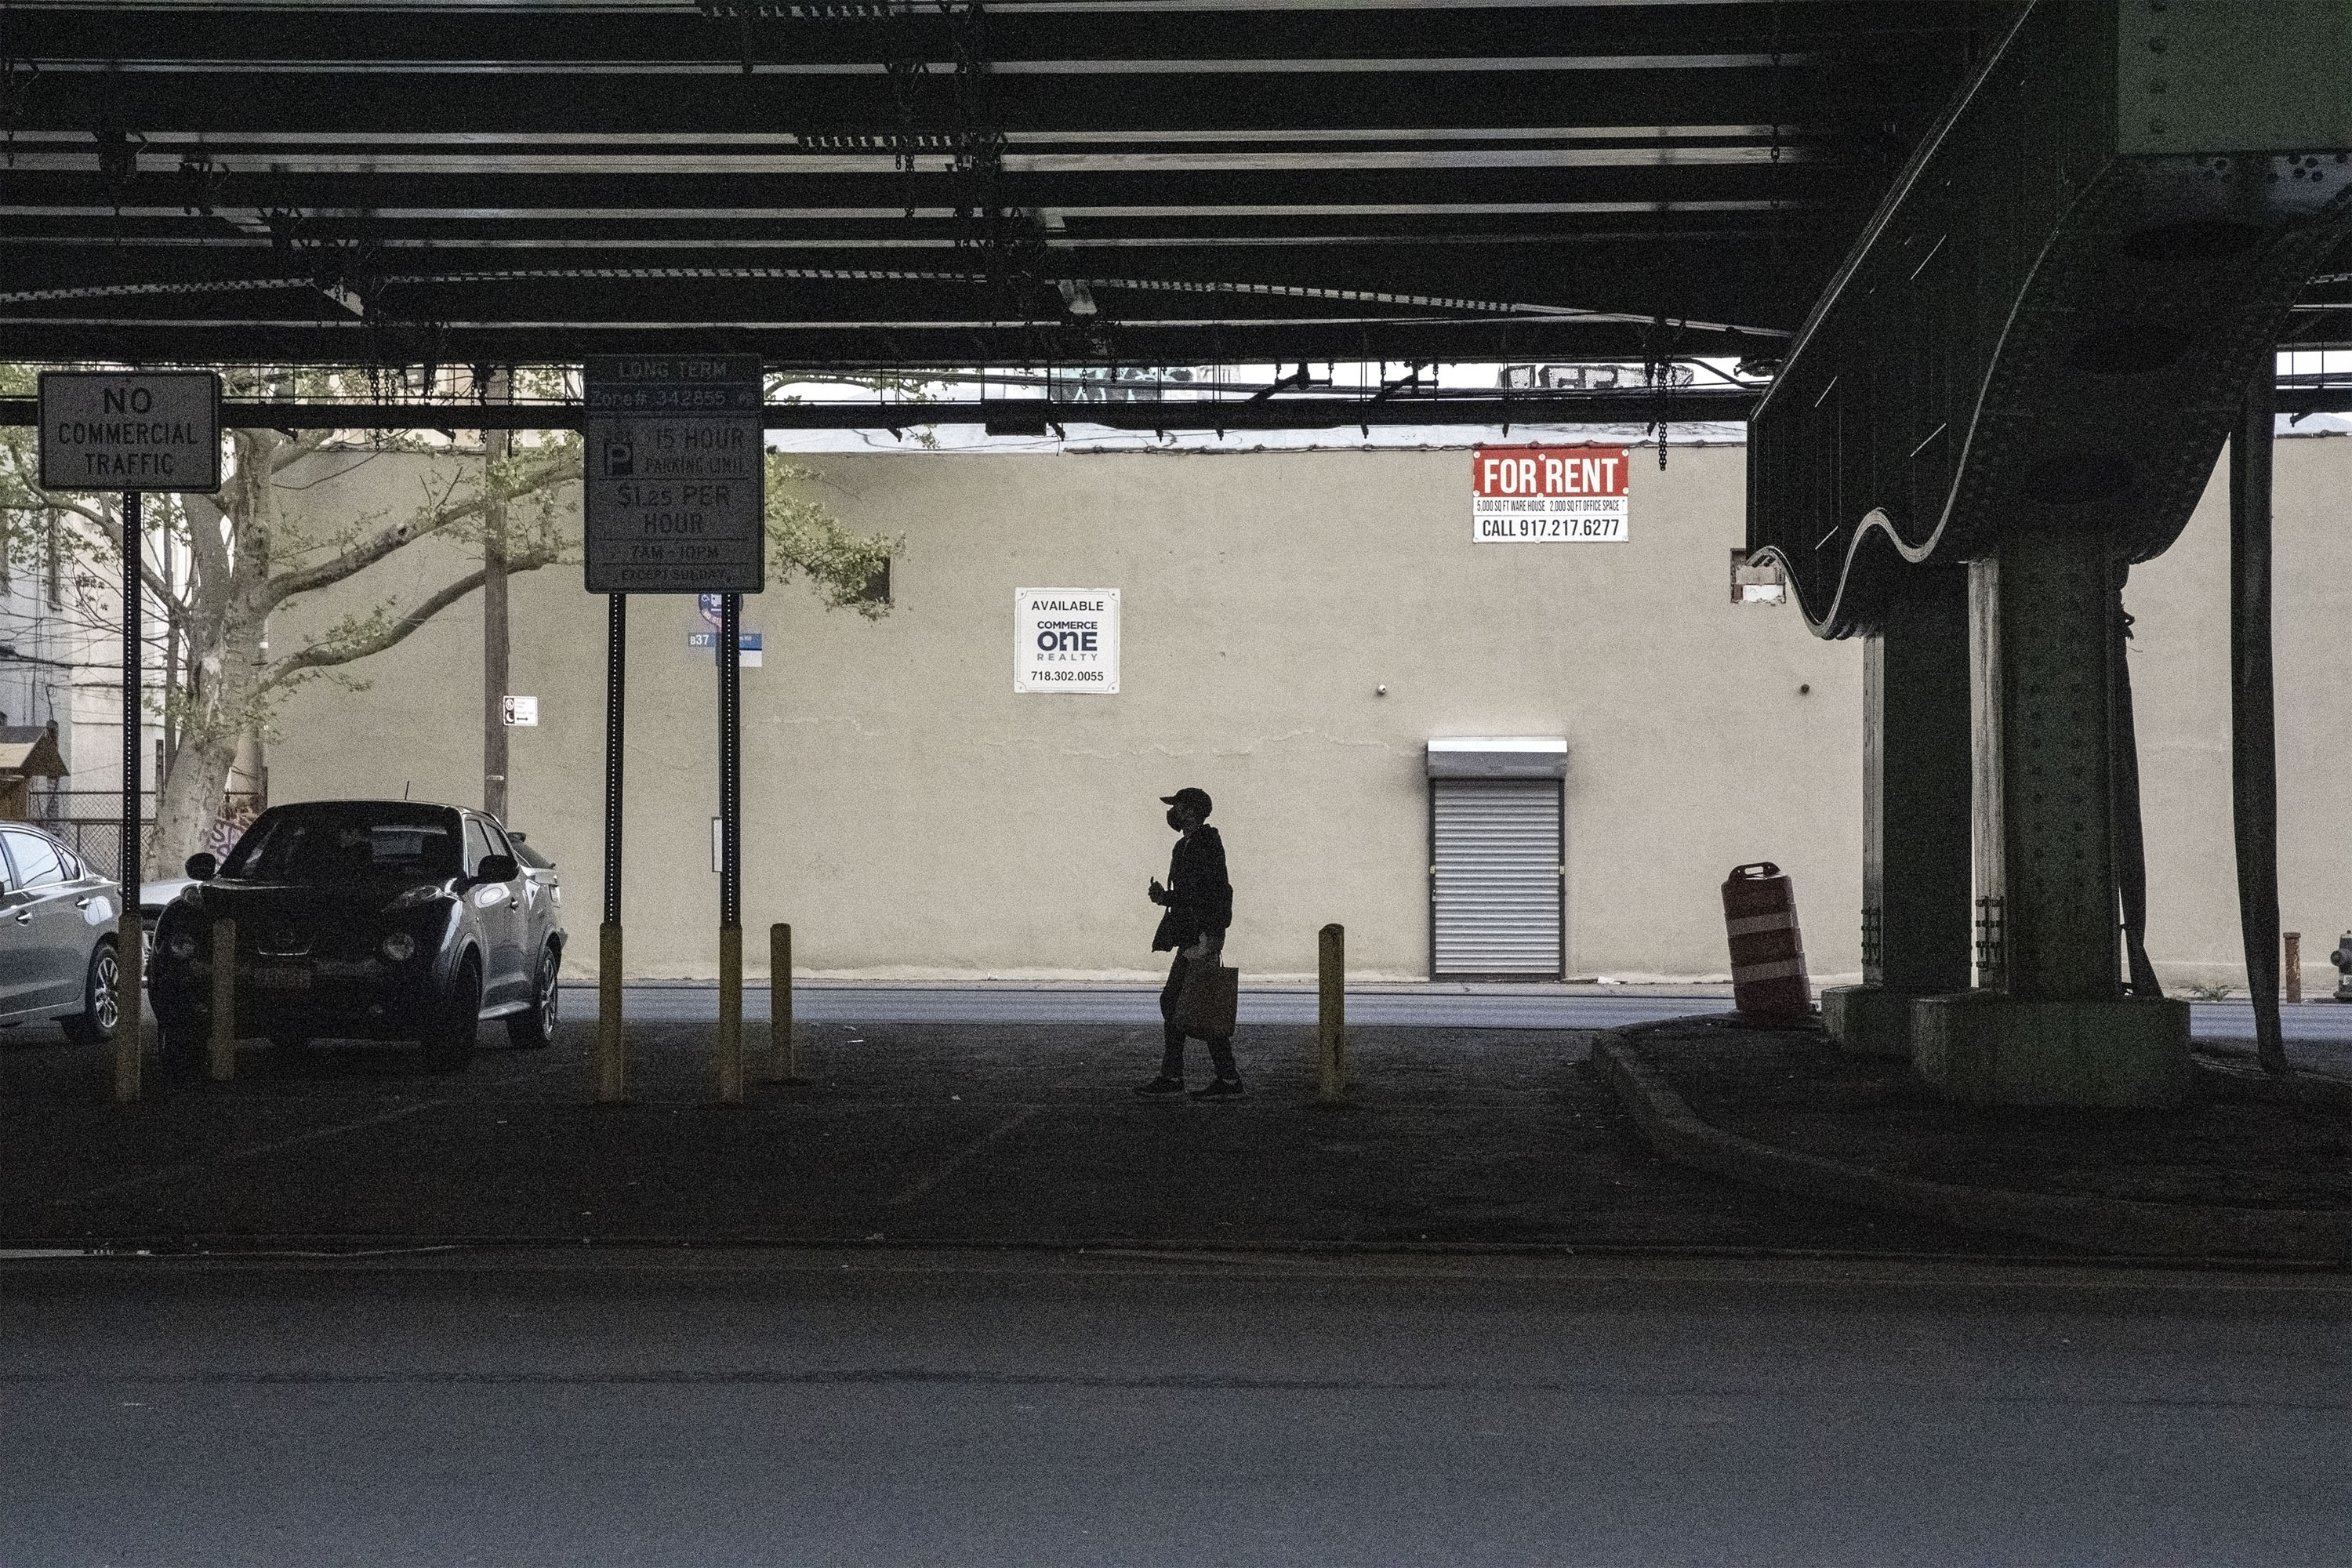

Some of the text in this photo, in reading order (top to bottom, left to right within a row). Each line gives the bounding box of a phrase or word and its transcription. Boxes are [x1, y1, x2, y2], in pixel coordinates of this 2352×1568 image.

[618, 361, 728, 379] LONG TERM
[103, 387, 153, 414] NO
[655, 390, 726, 407] 342855
[58, 422, 198, 445] COMMERCIAL
[655, 426, 744, 449] 15 HOUR
[84, 452, 174, 475] TRAFFIC
[645, 457, 705, 474] PARKING
[1484, 457, 1619, 493] FOR RENT
[681, 485, 731, 506] PER
[1476, 499, 1620, 512] 5,000 SQ FT WARE HOUSE 2,000 SQ FT OFFICE SPACE
[644, 512, 703, 534] HOUR
[1483, 519, 1620, 536] CALL 917.217.6277
[631, 546, 663, 559] 7AM
[680, 546, 718, 558] 10PM
[622, 569, 667, 581] EXCEPT
[1031, 601, 1104, 611] AVAILABLE
[1037, 620, 1098, 630] COMMERCE
[690, 634, 710, 645] B37
[1031, 671, 1104, 681] 718.302.0055
